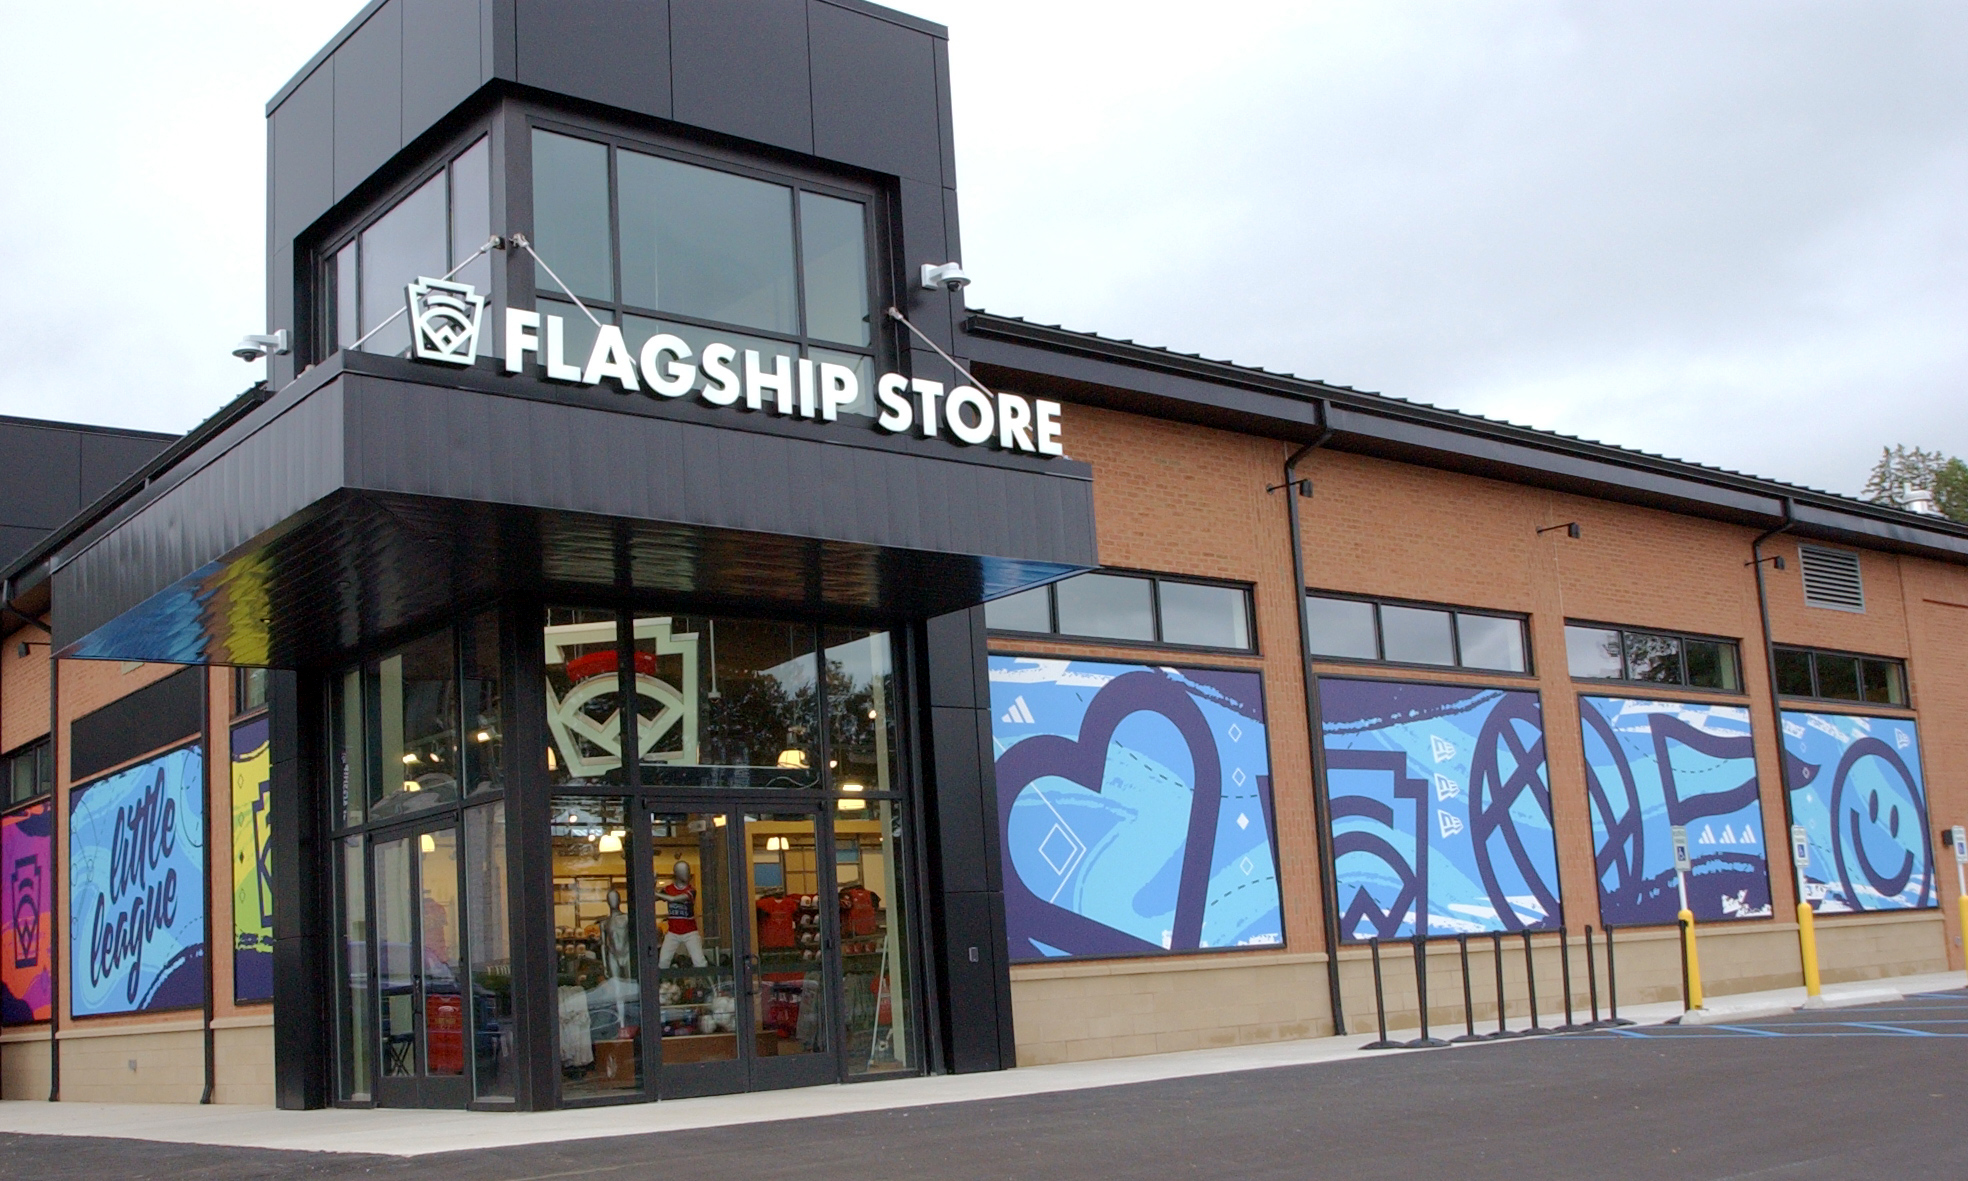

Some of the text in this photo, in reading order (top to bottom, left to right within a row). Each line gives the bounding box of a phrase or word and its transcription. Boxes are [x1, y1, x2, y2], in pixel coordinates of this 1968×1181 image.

[505, 307, 1064, 457] FLAGSHIP STORE
[110, 766, 177, 905] little
[90, 867, 179, 1005] league
